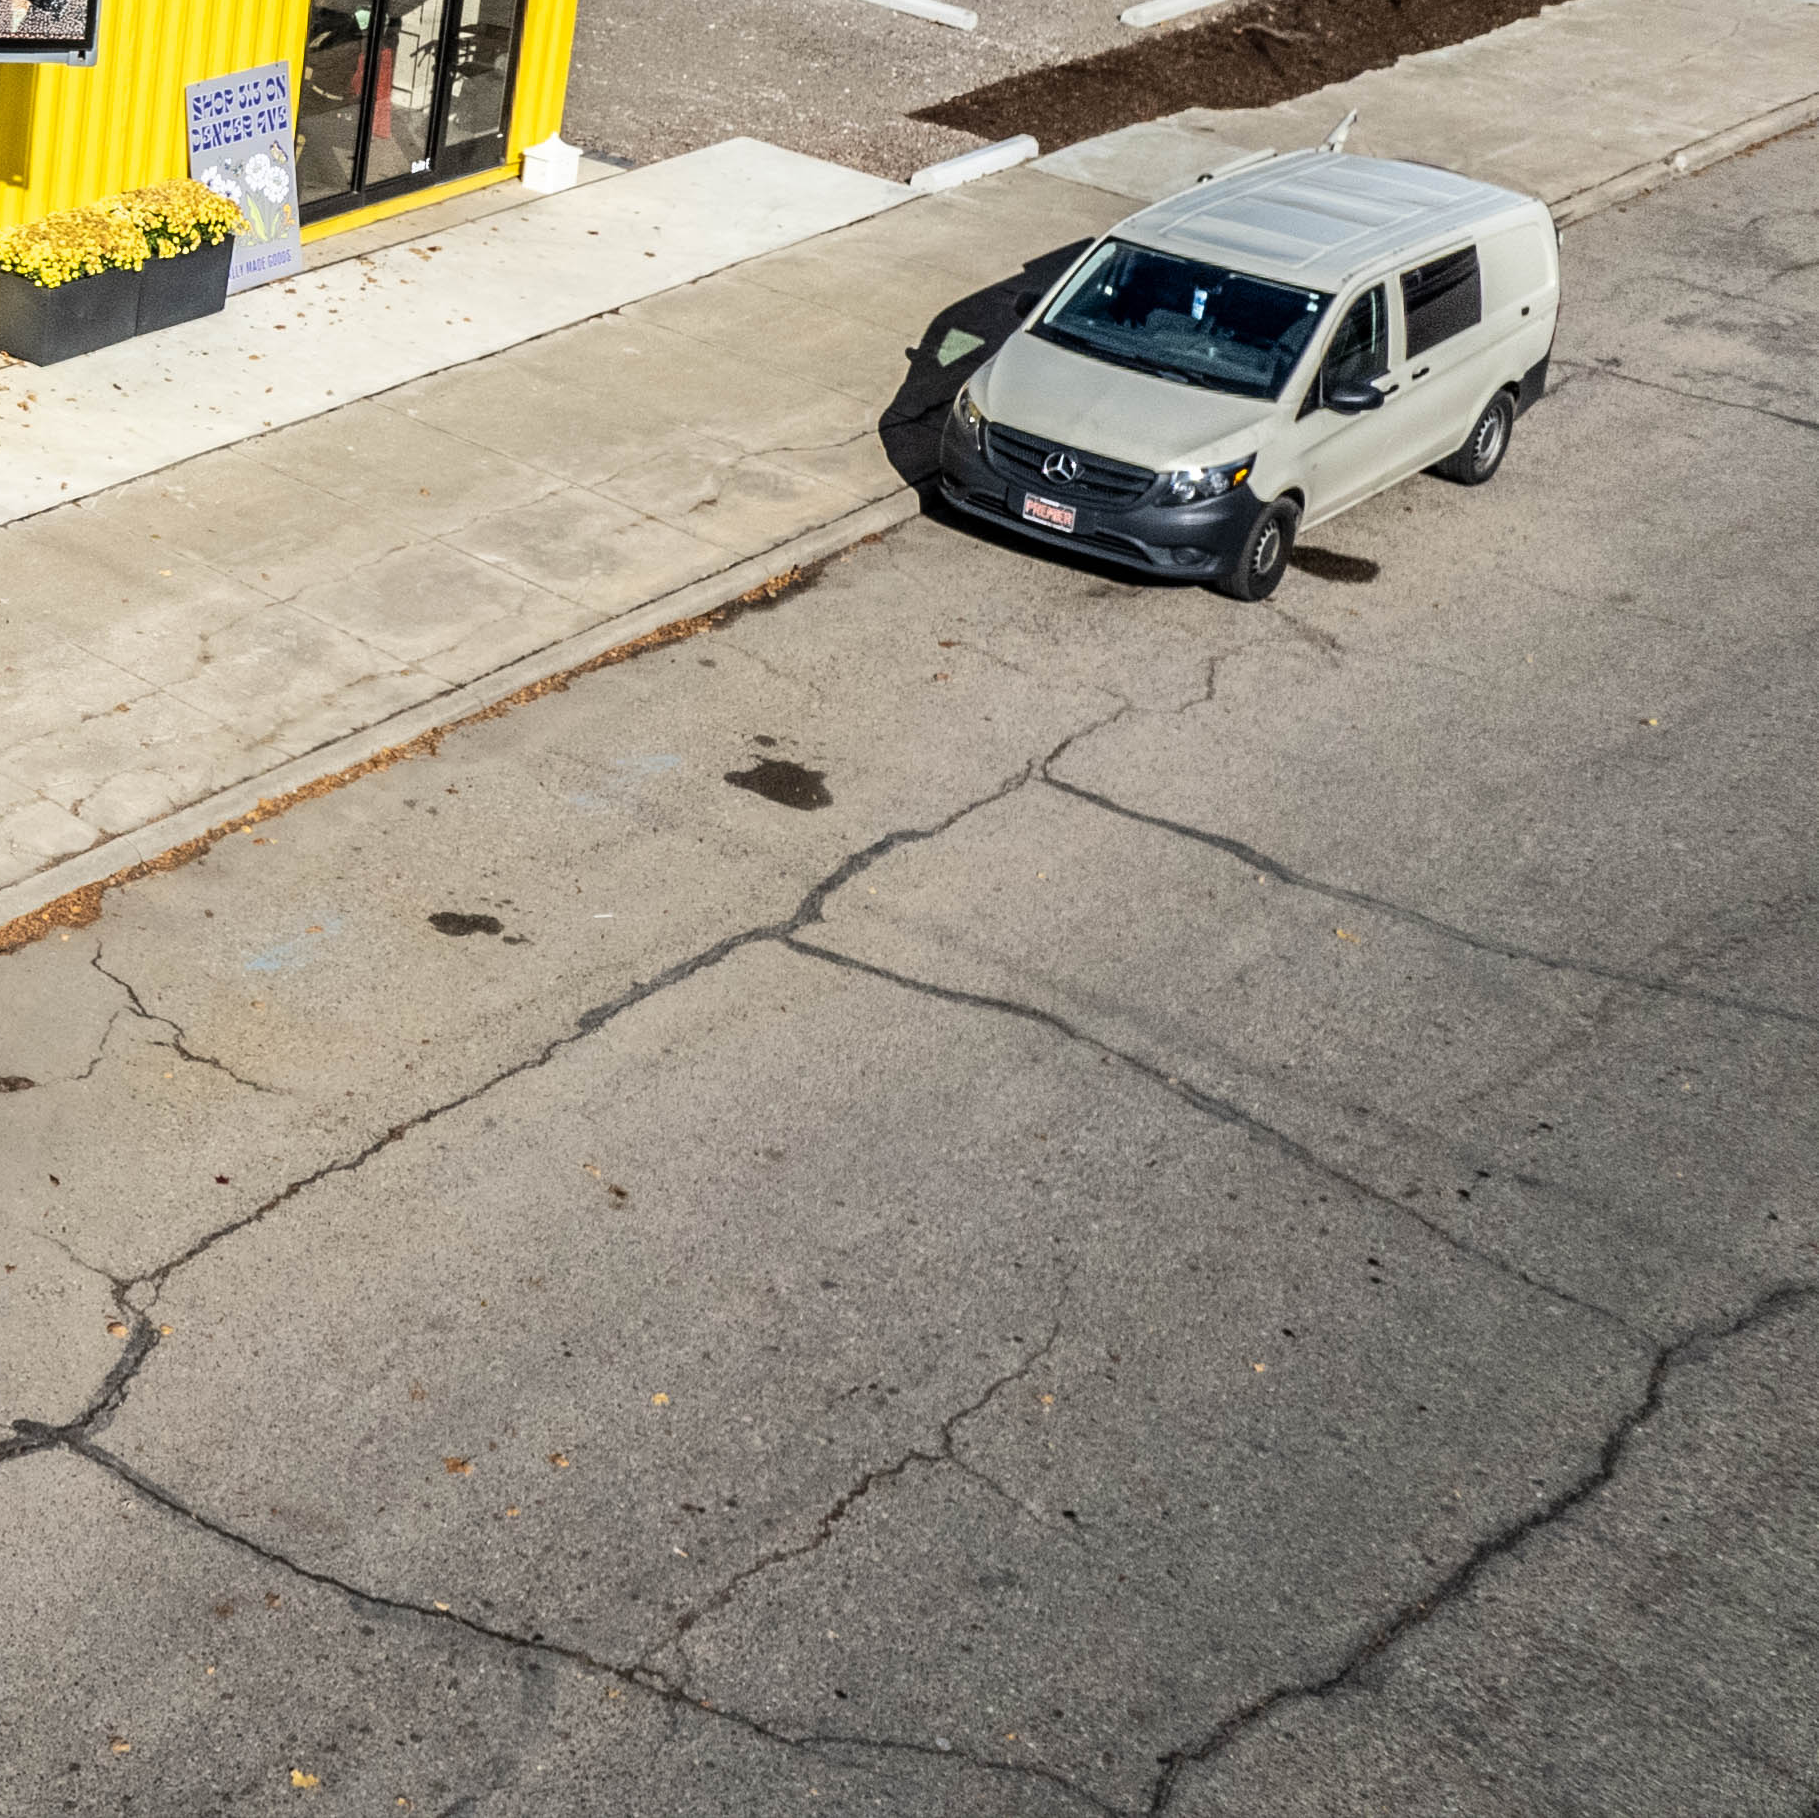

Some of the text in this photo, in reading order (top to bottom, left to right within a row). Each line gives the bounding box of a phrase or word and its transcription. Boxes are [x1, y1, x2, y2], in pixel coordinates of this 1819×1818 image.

[192, 75, 287, 121] SHOP 313 ON
[191, 105, 288, 153] DEXTER AVE
